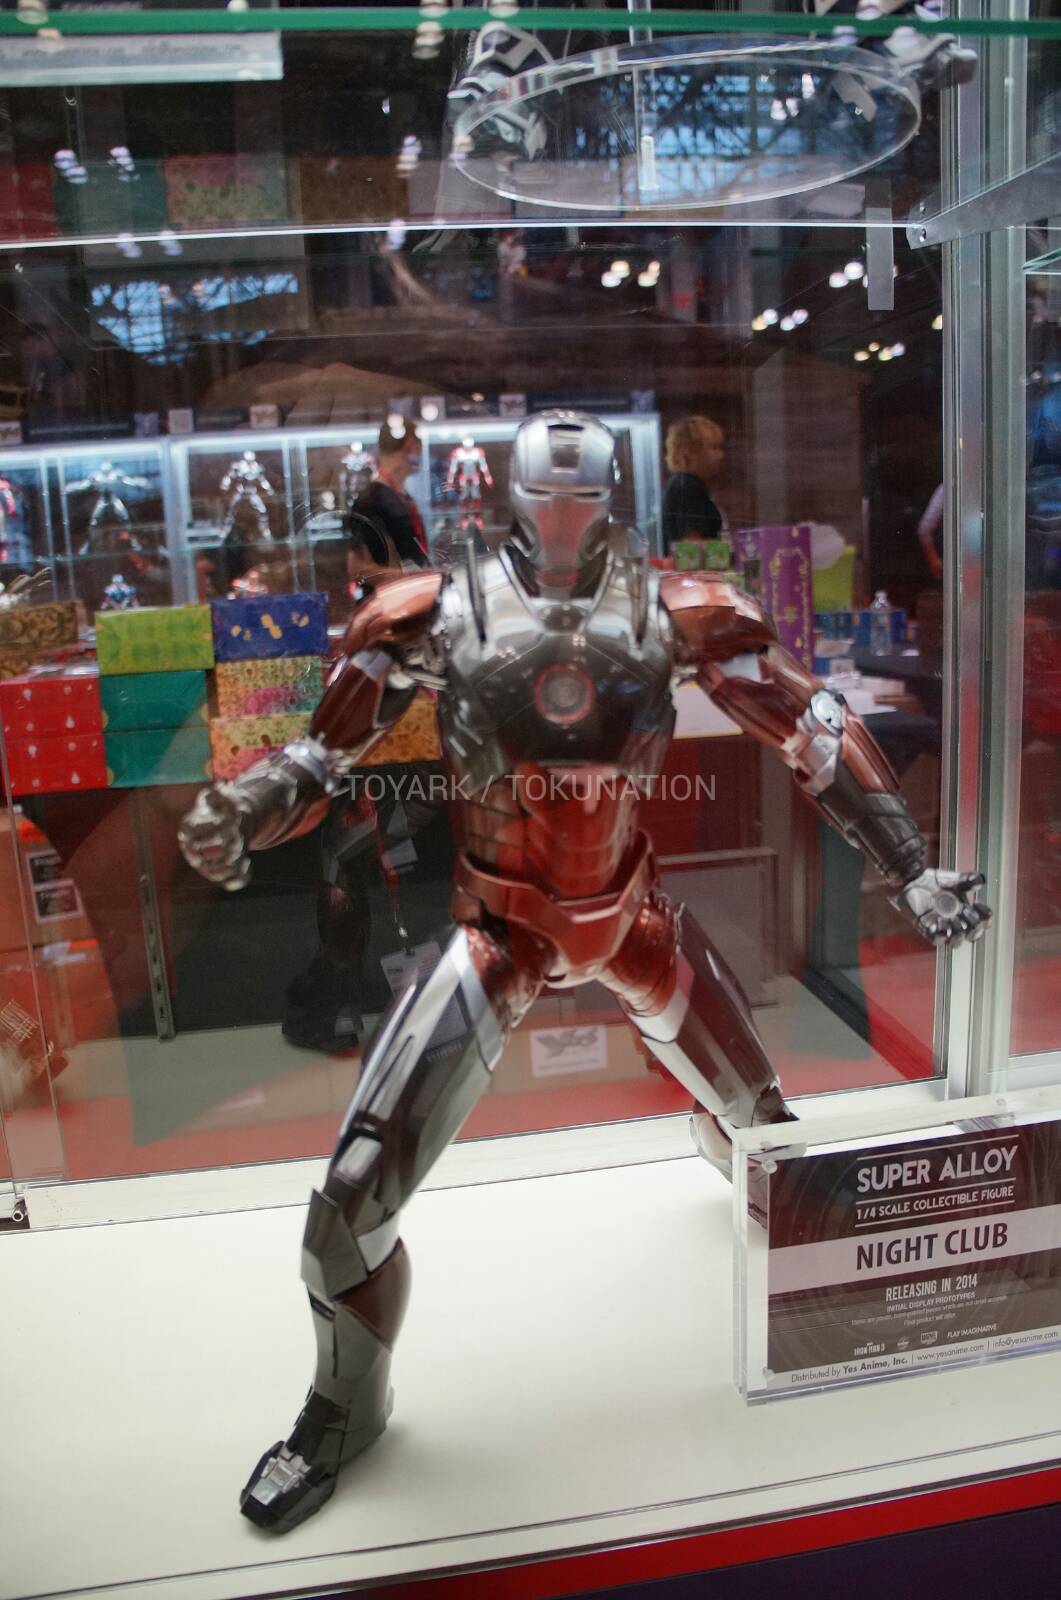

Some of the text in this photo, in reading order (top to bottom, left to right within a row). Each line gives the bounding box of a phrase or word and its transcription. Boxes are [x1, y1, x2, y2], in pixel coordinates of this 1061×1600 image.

[857, 1145, 1018, 1193] SUPER ALLOY
[856, 1186, 1014, 1221] 1/4 SCALE COLLECTIBLE FIGURE
[856, 1222, 1009, 1270] NIGHT CLUB
[886, 1273, 978, 1301] RELEASING IN 2014
[908, 1298, 935, 1309] DISPLAY
[935, 1291, 976, 1305] PROTOTYPES
[791, 1369, 830, 1383] Distributed
[831, 1367, 841, 1377] by
[843, 1363, 857, 1374] Yes
[860, 1357, 890, 1371] Anime,
[892, 1356, 908, 1366] Inc.
[917, 1343, 985, 1361] www.yesanime.com
